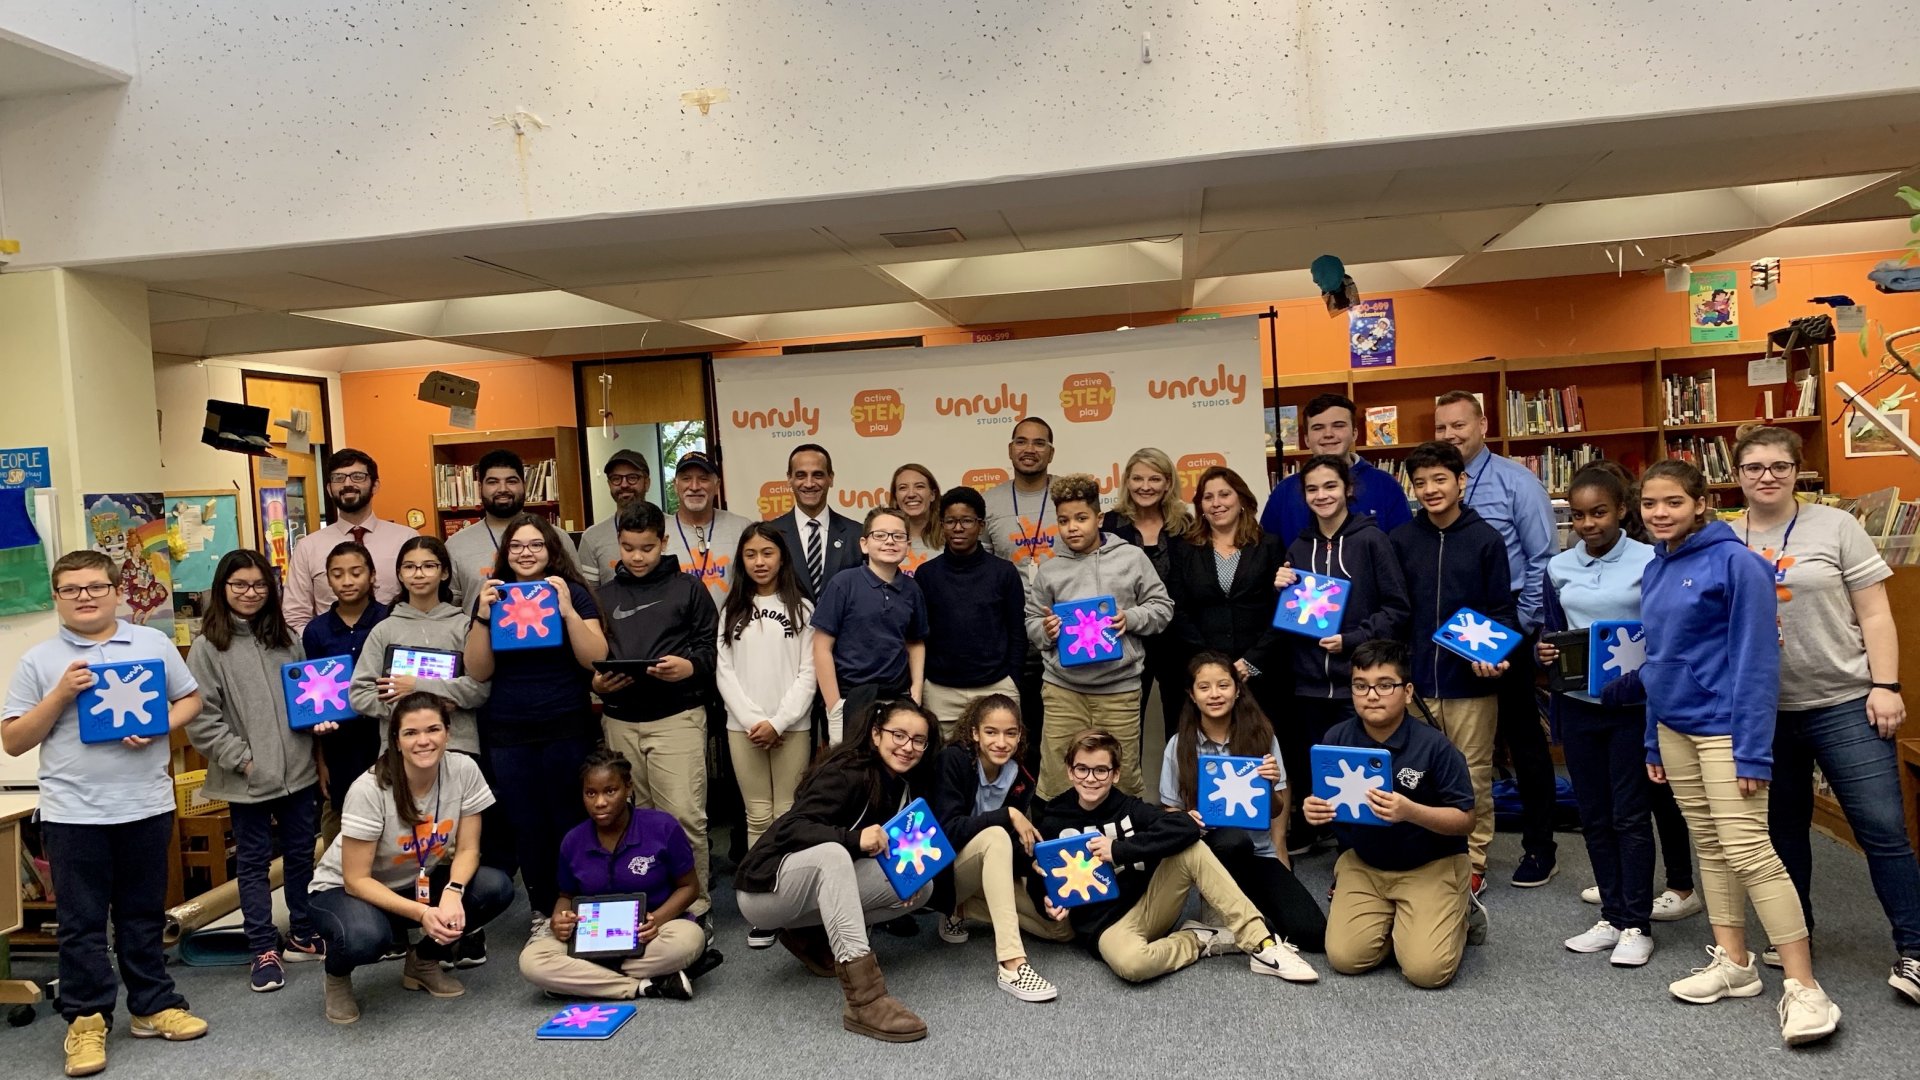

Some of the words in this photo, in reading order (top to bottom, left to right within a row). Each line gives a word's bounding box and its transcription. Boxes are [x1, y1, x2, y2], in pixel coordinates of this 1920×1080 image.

[976, 333, 1010, 343] 500-599
[1073, 377, 1102, 387] active
[1148, 363, 1247, 405] unruly
[864, 393, 892, 403] active
[935, 382, 1028, 422] unruly
[1059, 386, 1117, 409] STEM
[1191, 399, 1230, 408] STUDIOS
[732, 397, 820, 436] unruly
[851, 403, 905, 423] STEM
[976, 416, 1012, 425] STUDIOS
[1079, 408, 1099, 418] play
[771, 431, 806, 439] STUDIOS
[870, 423, 889, 433] play
[0, 452, 42, 469] EOPLE
[1187, 458, 1217, 468] active
[972, 473, 1001, 482] active
[769, 485, 794, 494] active
[757, 495, 798, 515] STE
[839, 487, 891, 510] unr
[685, 561, 725, 578] unuly
[525, 584, 543, 600] unruly
[121, 663, 144, 682] unruly
[319, 659, 337, 675] unruly
[1236, 760, 1256, 776] unruly
[905, 810, 916, 833] unruly
[1092, 870, 1112, 886] unruly
